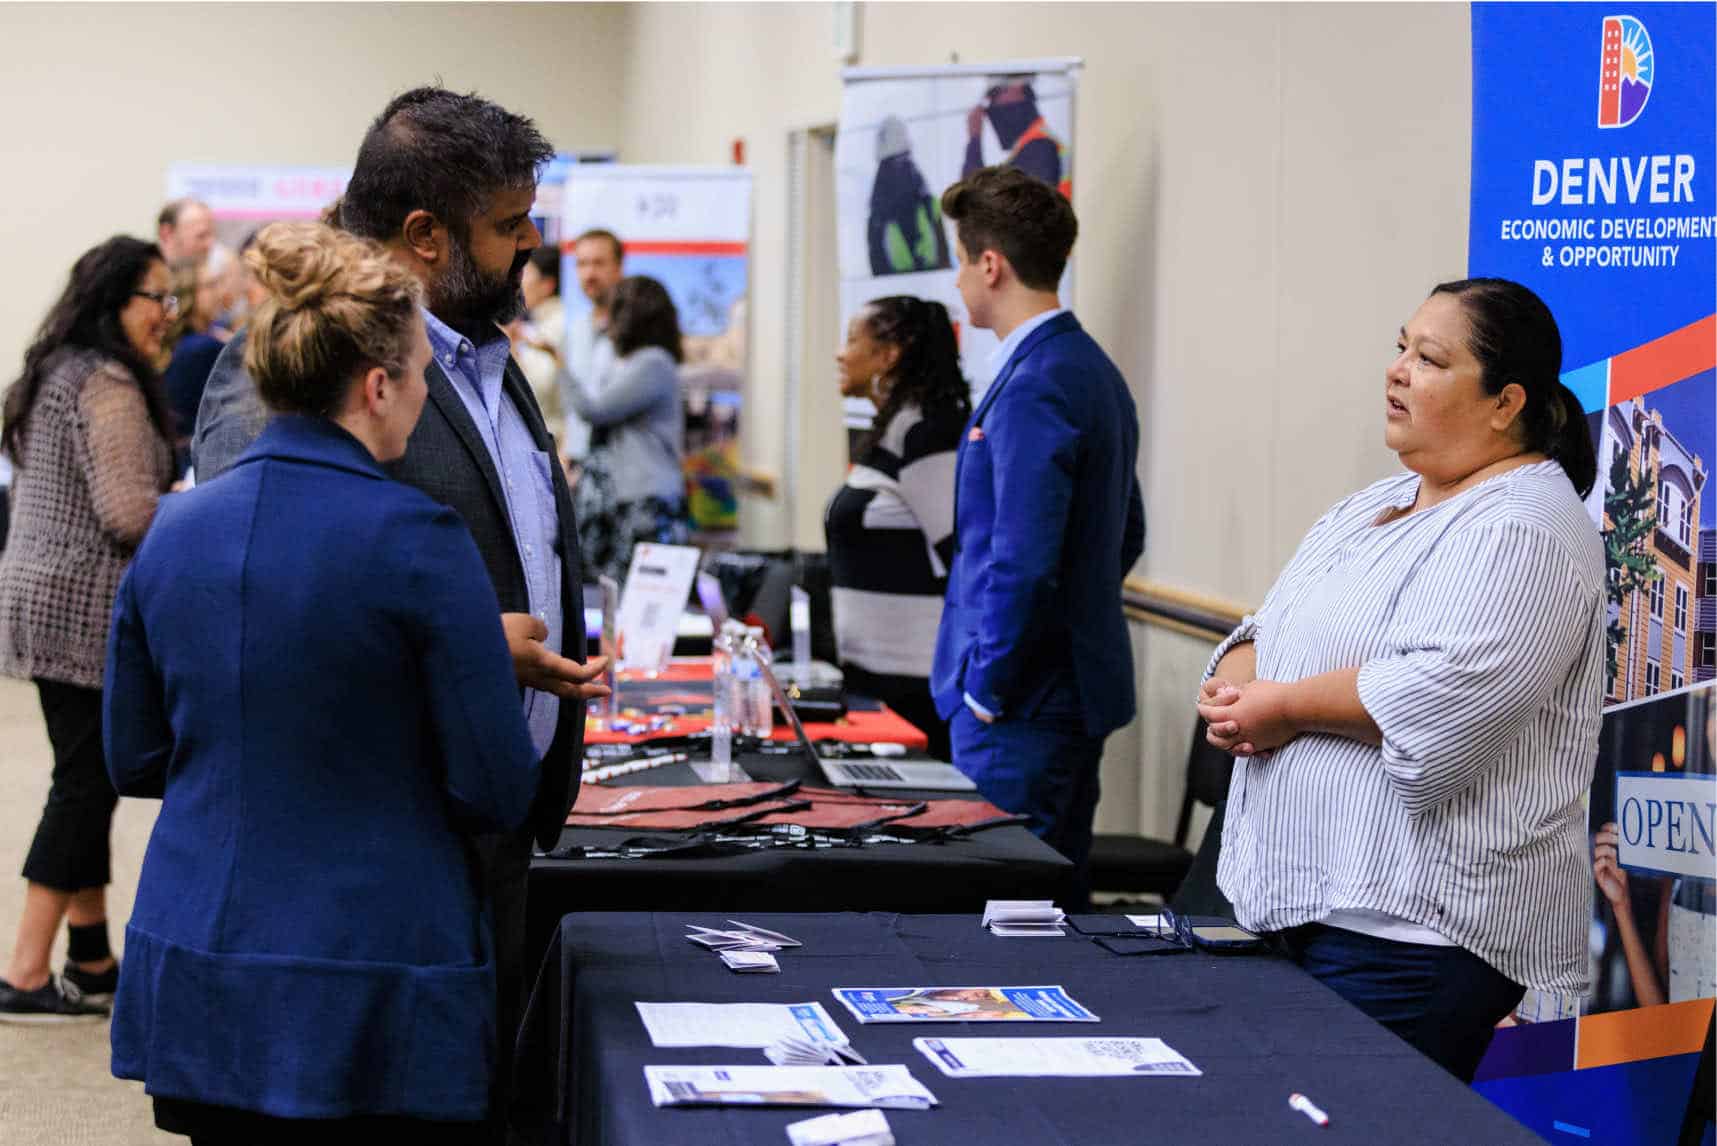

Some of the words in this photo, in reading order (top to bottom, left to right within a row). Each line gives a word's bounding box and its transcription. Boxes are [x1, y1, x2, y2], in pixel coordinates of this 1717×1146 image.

[1532, 154, 1696, 206] DENVER
[1501, 218, 1595, 240] ECONOMIC
[1541, 246, 1554, 267] &
[1559, 244, 1680, 267] OPPORTUNITY
[1622, 796, 1717, 856] OPEN
